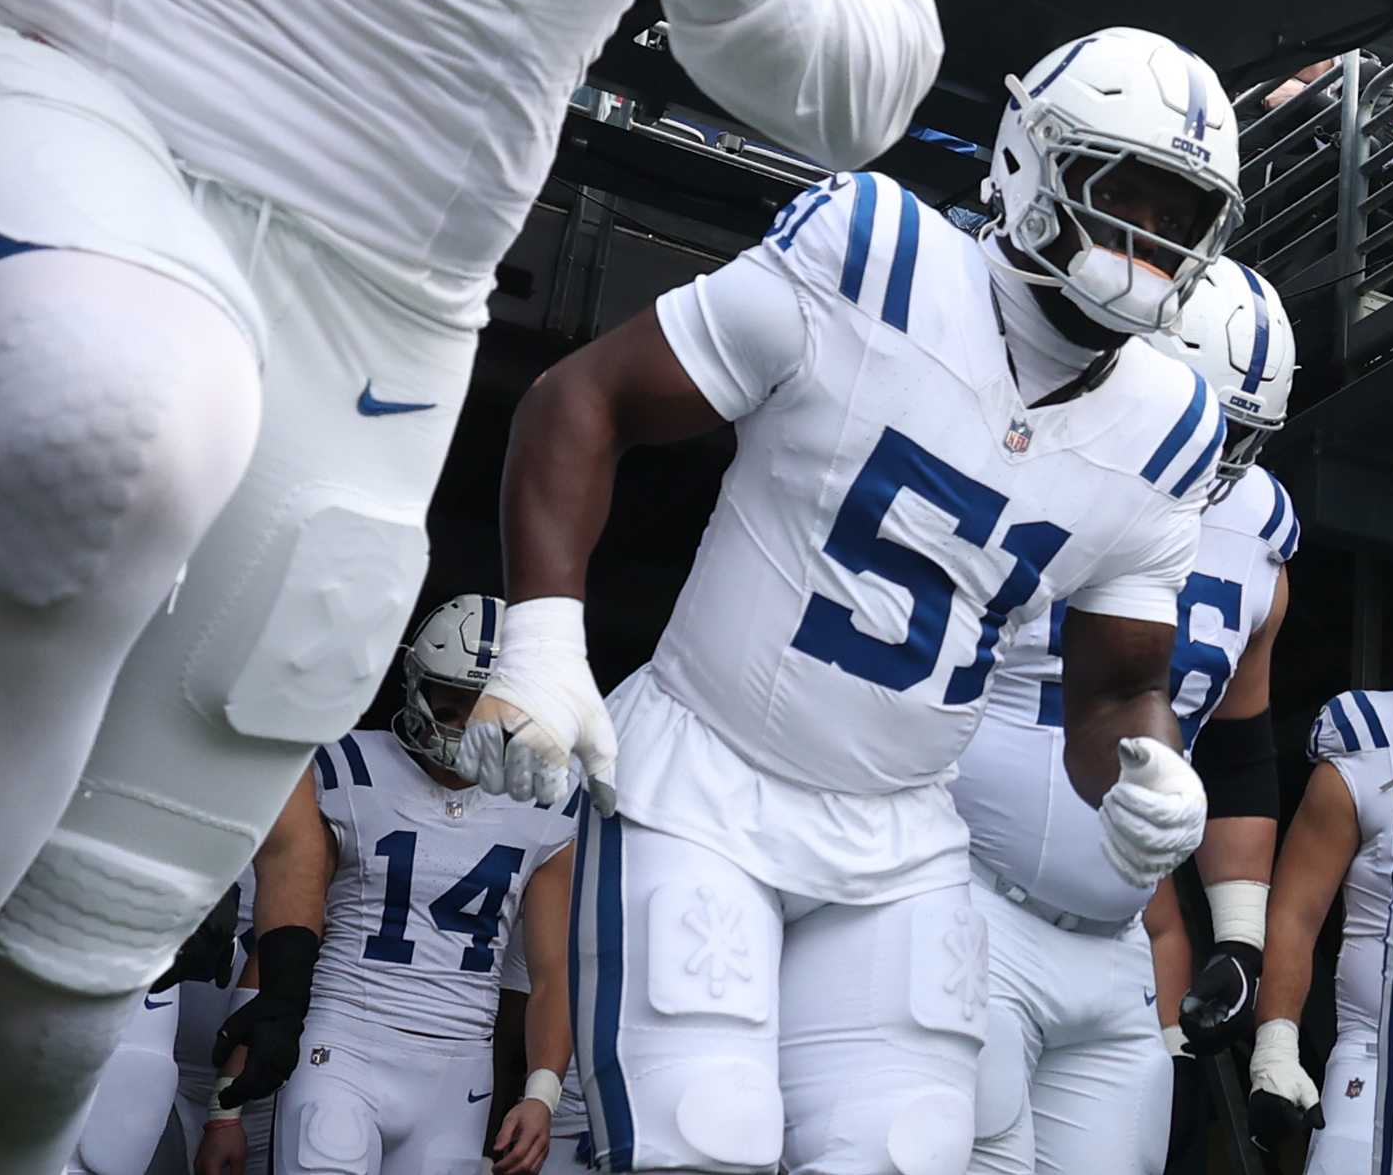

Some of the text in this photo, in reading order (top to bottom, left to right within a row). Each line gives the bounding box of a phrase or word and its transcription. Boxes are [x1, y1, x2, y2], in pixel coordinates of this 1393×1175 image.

[1171, 137, 1211, 163] COLTS
[1229, 395, 1262, 414] COLTS
[790, 425, 1074, 706] 51
[467, 670, 491, 681] COLT
[363, 830, 526, 972] 14
